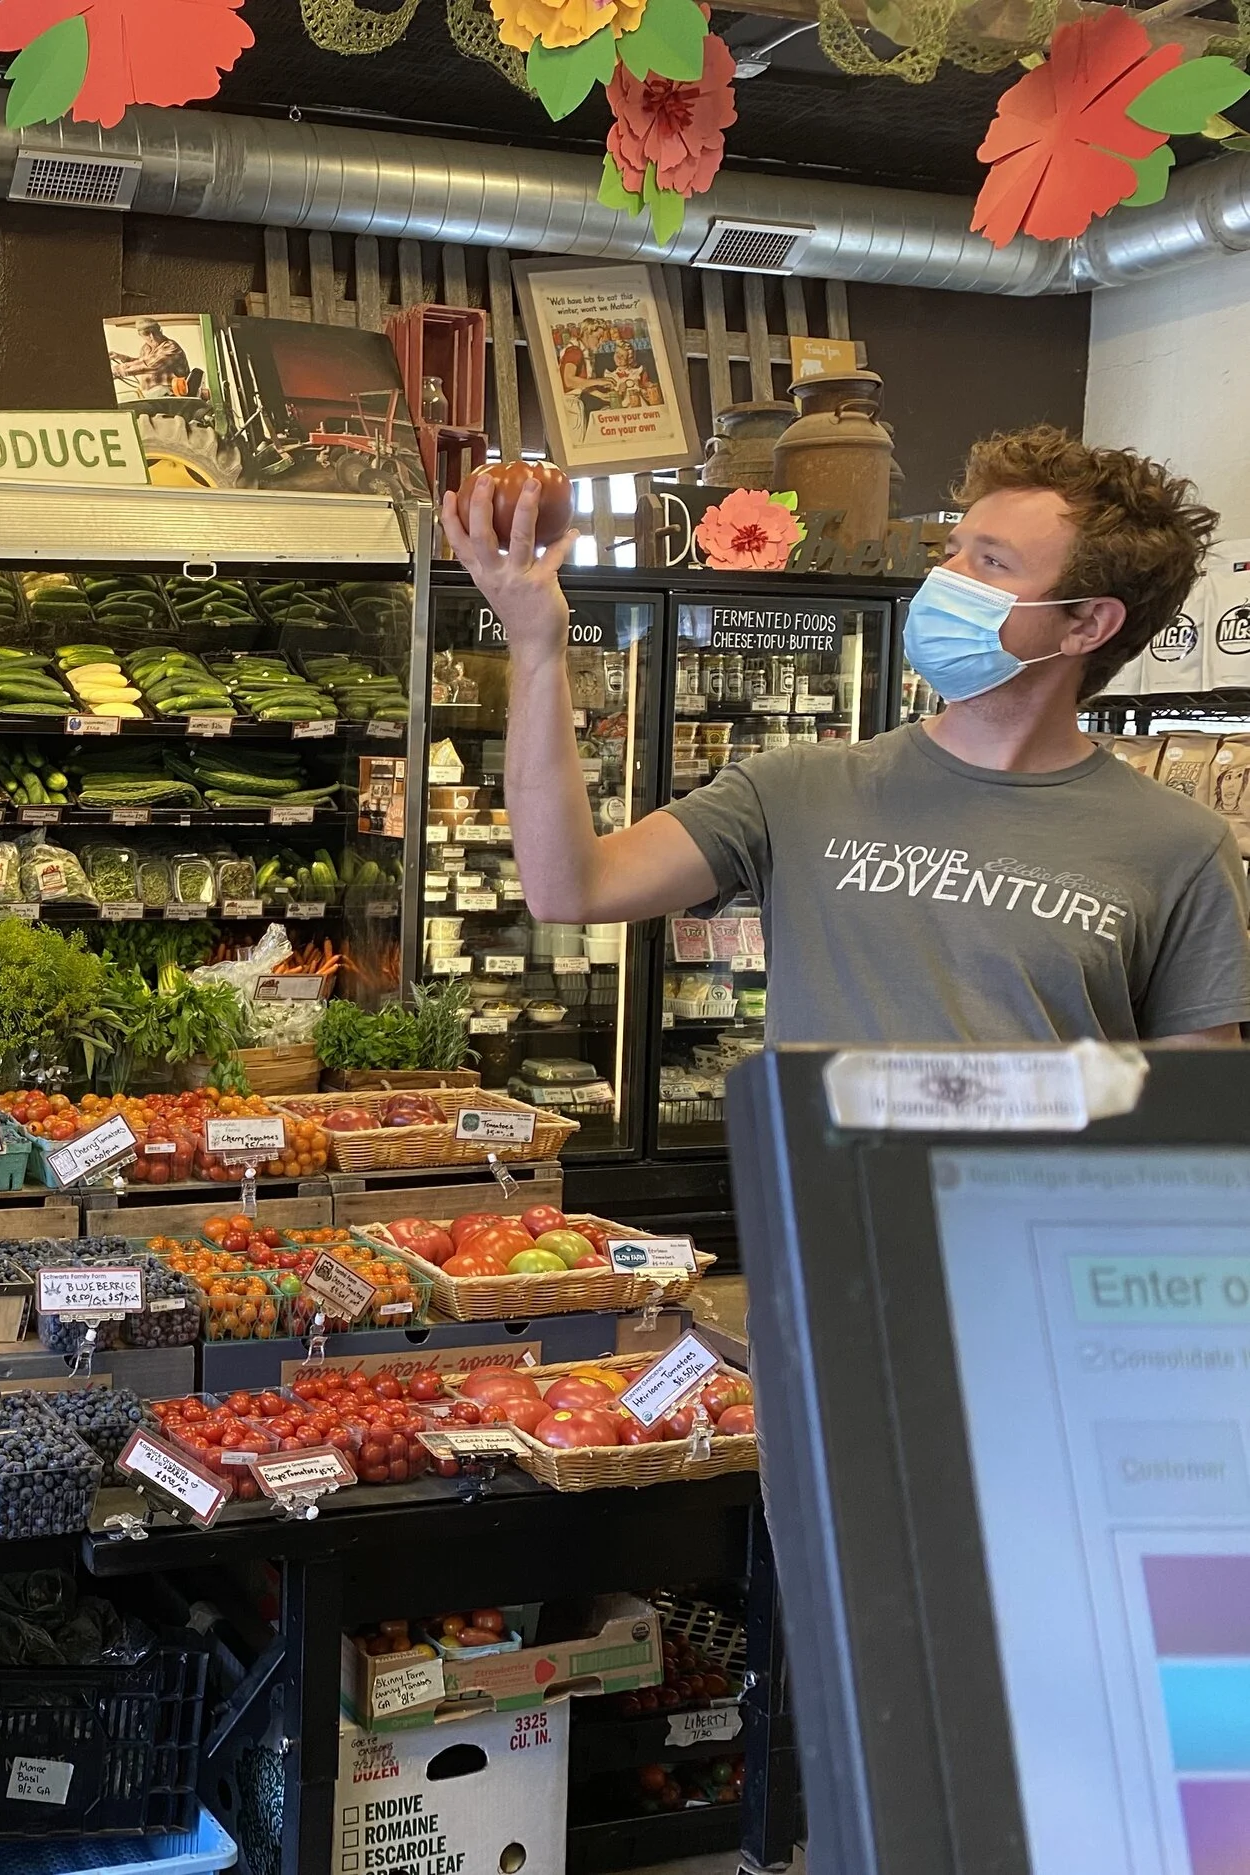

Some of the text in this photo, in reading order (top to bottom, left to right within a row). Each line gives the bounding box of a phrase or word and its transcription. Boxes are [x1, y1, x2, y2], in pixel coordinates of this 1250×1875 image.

[598, 411, 661, 424] Grow your own
[600, 424, 656, 436] Can your own
[713, 608, 837, 633] FERMENTED FOODS
[824, 838, 970, 875] LIVE YOUR
[984, 857, 1055, 882] Eddie
[836, 858, 1128, 942] ADVENTURE
[73, 1127, 127, 1158] Cherry Tomatoes
[221, 1134, 244, 1145] Cherry
[65, 1281, 137, 1292] BLUEBERRIES
[1088, 1267, 1208, 1309] Enter
[1108, 1346, 1236, 1371] Consolidate
[632, 1351, 697, 1407] Heirloom Tomatoes
[641, 1365, 665, 1387] GARDENS
[138, 1440, 189, 1477] Kapnick Orchards
[264, 1473, 287, 1483] Grape
[1120, 1456, 1226, 1485] Customer
[375, 1670, 426, 1689] Skinny Farm
[474, 1662, 531, 1677] Strawberries
[515, 1712, 548, 1733] 3325
[684, 1711, 727, 1730] LIBERTY
[510, 1729, 552, 1751] CU. IN.
[16, 1771, 40, 1785] Basil
[19, 1760, 47, 1775] Monroe
[352, 1765, 400, 1784] DOZEN
[364, 1794, 423, 1823] ENDIVE
[364, 1814, 439, 1846] ROMAINE
[364, 1836, 447, 1869] ESCAROLE
[426, 1852, 466, 1875] LEAF
